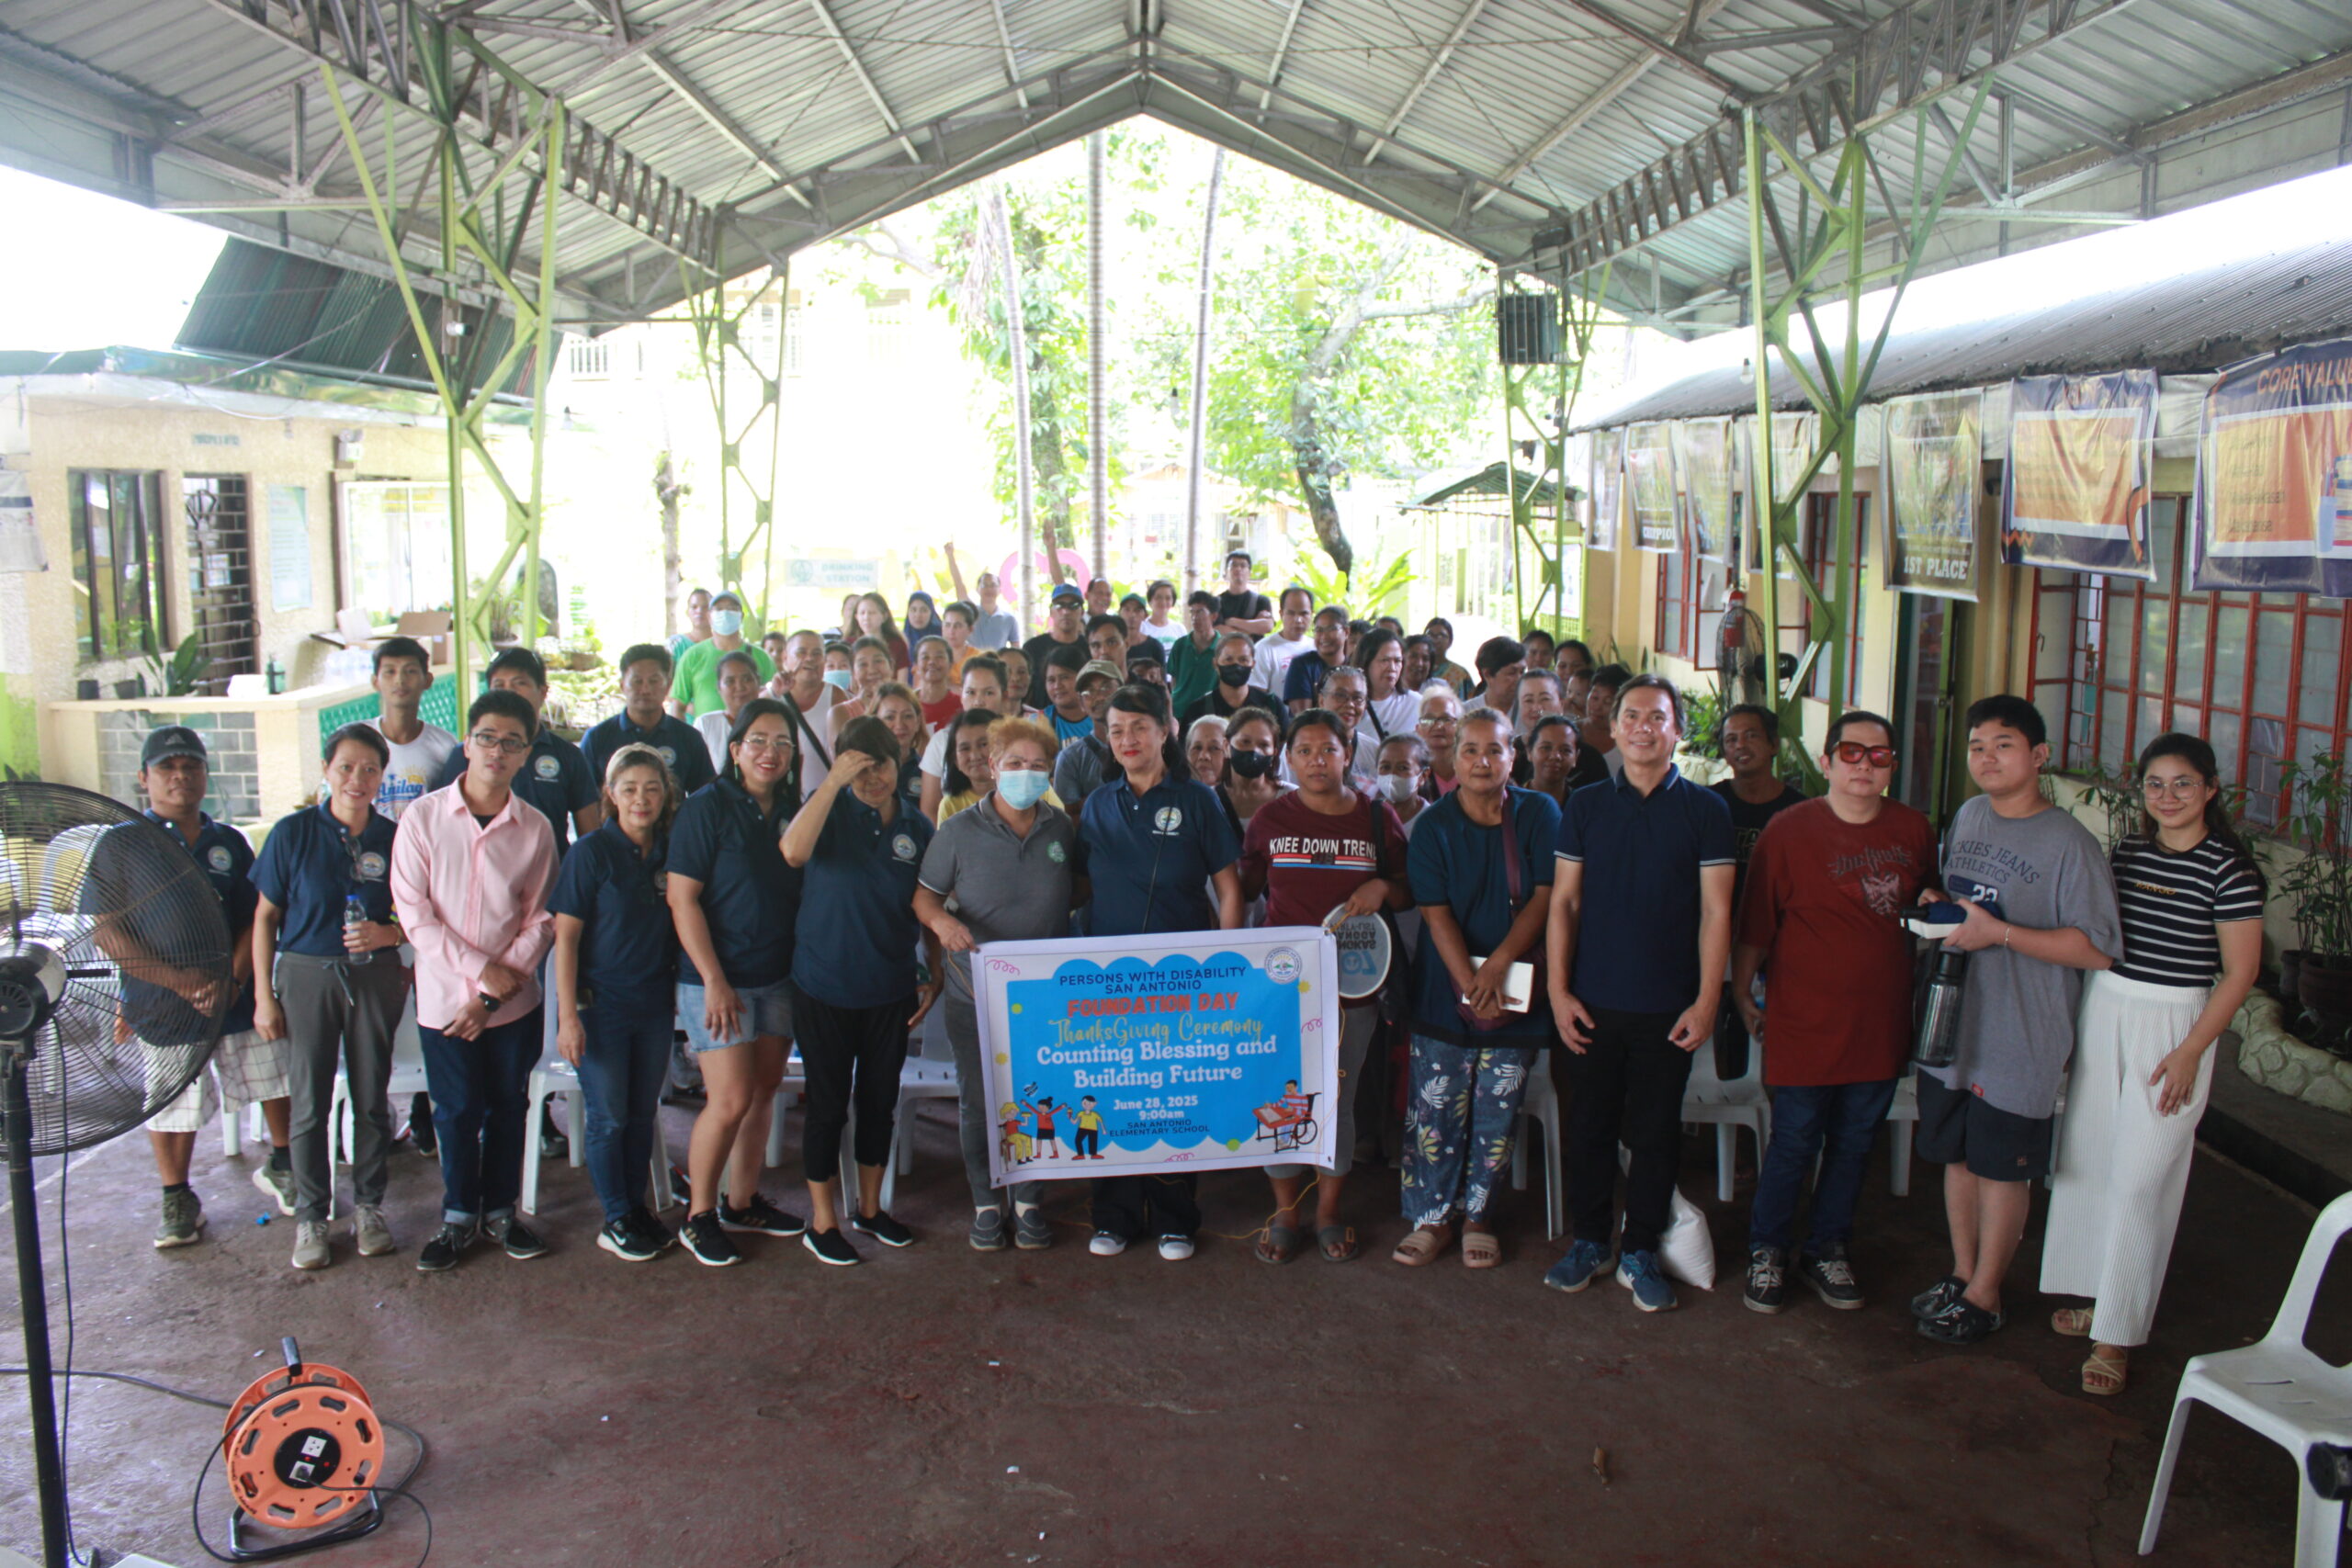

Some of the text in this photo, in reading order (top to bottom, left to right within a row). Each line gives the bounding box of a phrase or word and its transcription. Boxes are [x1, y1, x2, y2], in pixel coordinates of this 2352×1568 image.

[2257, 364, 2301, 395] CORE
[821, 562, 874, 571] DRINKING
[1904, 556, 1968, 580] 1ST PLACE
[826, 574, 870, 582] STATION
[1269, 837, 1299, 855] KNEE
[1302, 838, 1340, 855] DOWN
[1948, 856, 2010, 884] ATHLETICS
[1991, 847, 2040, 884] JEANS
[1059, 966, 1247, 986] PERSONS WITH DISABILITY
[1105, 979, 1202, 994] SAN ANTONIO
[1067, 992, 1239, 1018] FOUNDATION DAY
[1047, 1013, 1263, 1048] ThanksGiving Ceremony
[1036, 1035, 1277, 1066] Counting Blessing and
[1073, 1064, 1243, 1089] Building Future
[1113, 1095, 1199, 1111] June 28, 2025
[1126, 1119, 1193, 1129] SAN ANTONIO
[1138, 1109, 1185, 1121] 9:00am
[1109, 1124, 1211, 1137] ELEMENTARY SCHOOL
